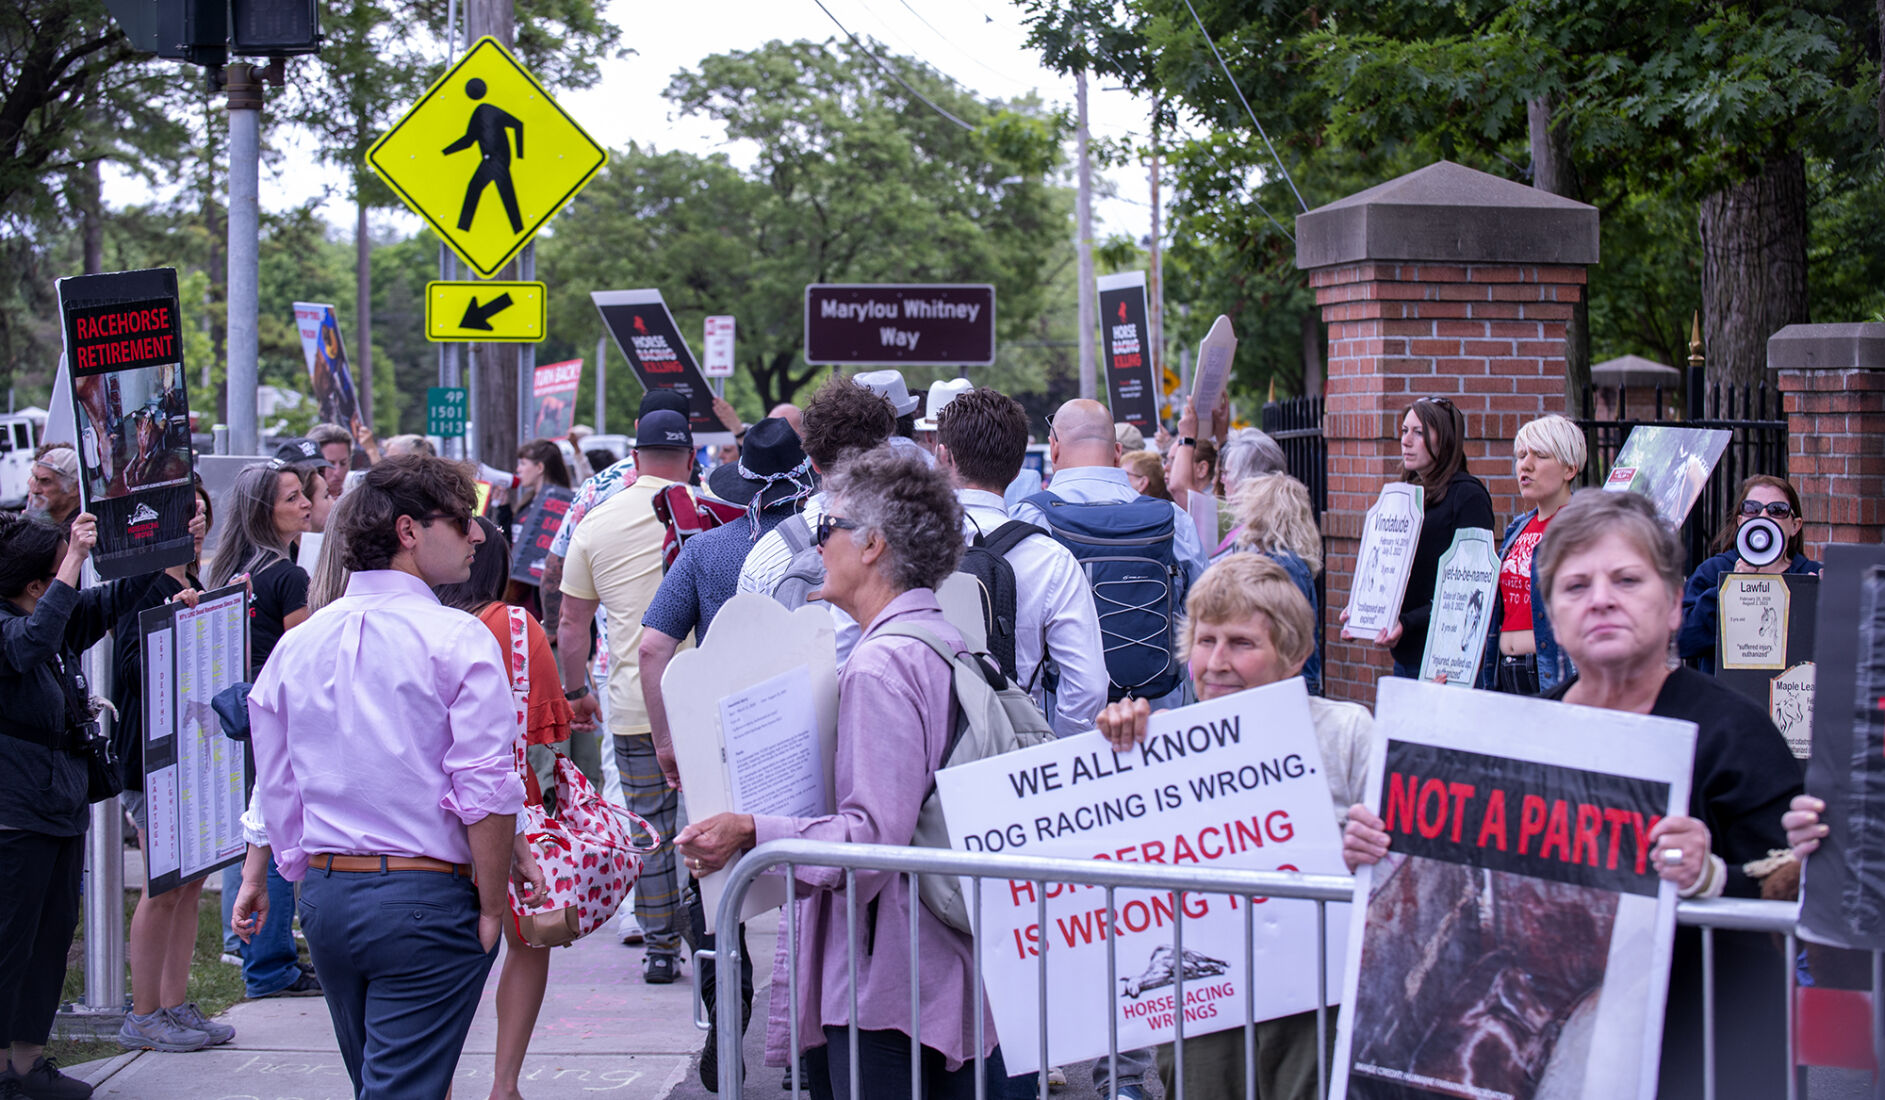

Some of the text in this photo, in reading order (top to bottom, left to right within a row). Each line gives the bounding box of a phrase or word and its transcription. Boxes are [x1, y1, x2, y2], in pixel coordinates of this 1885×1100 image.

[76, 307, 169, 340] RACEHORSE
[821, 299, 981, 323] Marylou Whitney
[77, 335, 174, 368] RETIREMENT
[879, 326, 920, 351] Way
[431, 406, 462, 418] 1501
[1374, 512, 1409, 533] Vindatude
[1442, 564, 1493, 584] yet-to-be-named
[1740, 581, 1770, 593] Lawful
[1776, 681, 1815, 692] Maple Lea
[1008, 715, 1242, 799] WE ALL KNOW
[964, 753, 1316, 852] DOG RACING IS WRONG.
[1385, 772, 1662, 875] NOT A PARTY
[1013, 891, 1209, 960] IS WRONG
[1123, 982, 1235, 1019] HORSEACING
[1147, 1002, 1218, 1031] WRNGS
